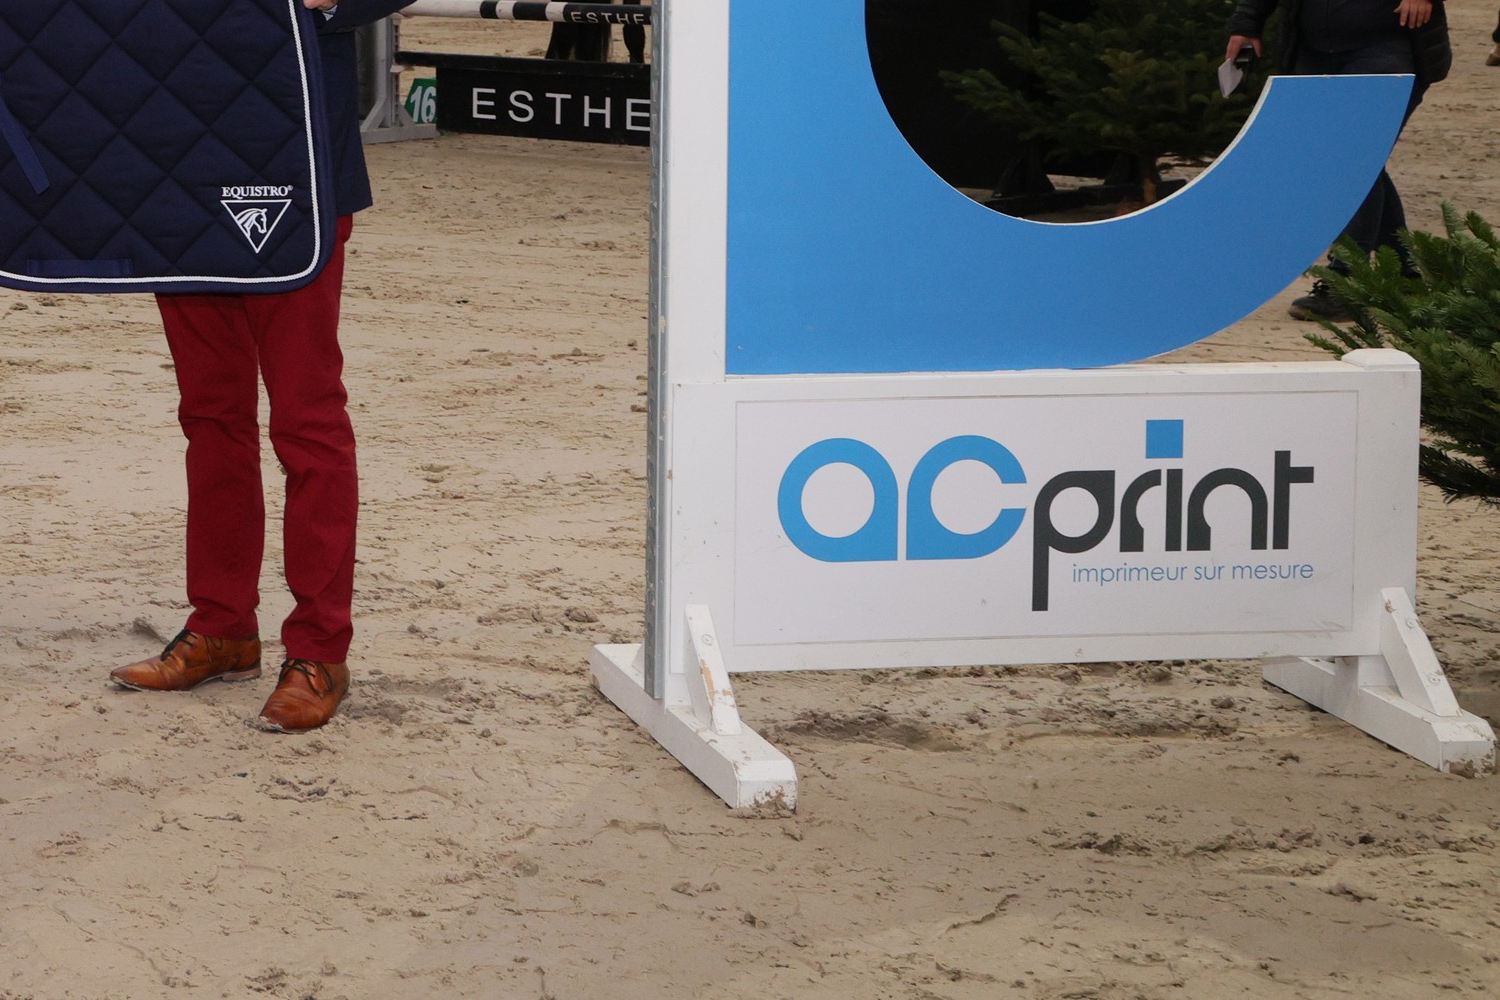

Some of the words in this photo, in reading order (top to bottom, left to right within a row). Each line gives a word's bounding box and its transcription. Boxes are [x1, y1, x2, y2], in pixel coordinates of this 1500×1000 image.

[409, 85, 437, 124] 16
[1072, 562, 1188, 587] imprimeur
[1193, 563, 1226, 581] sur
[1232, 561, 1315, 581] mesure
